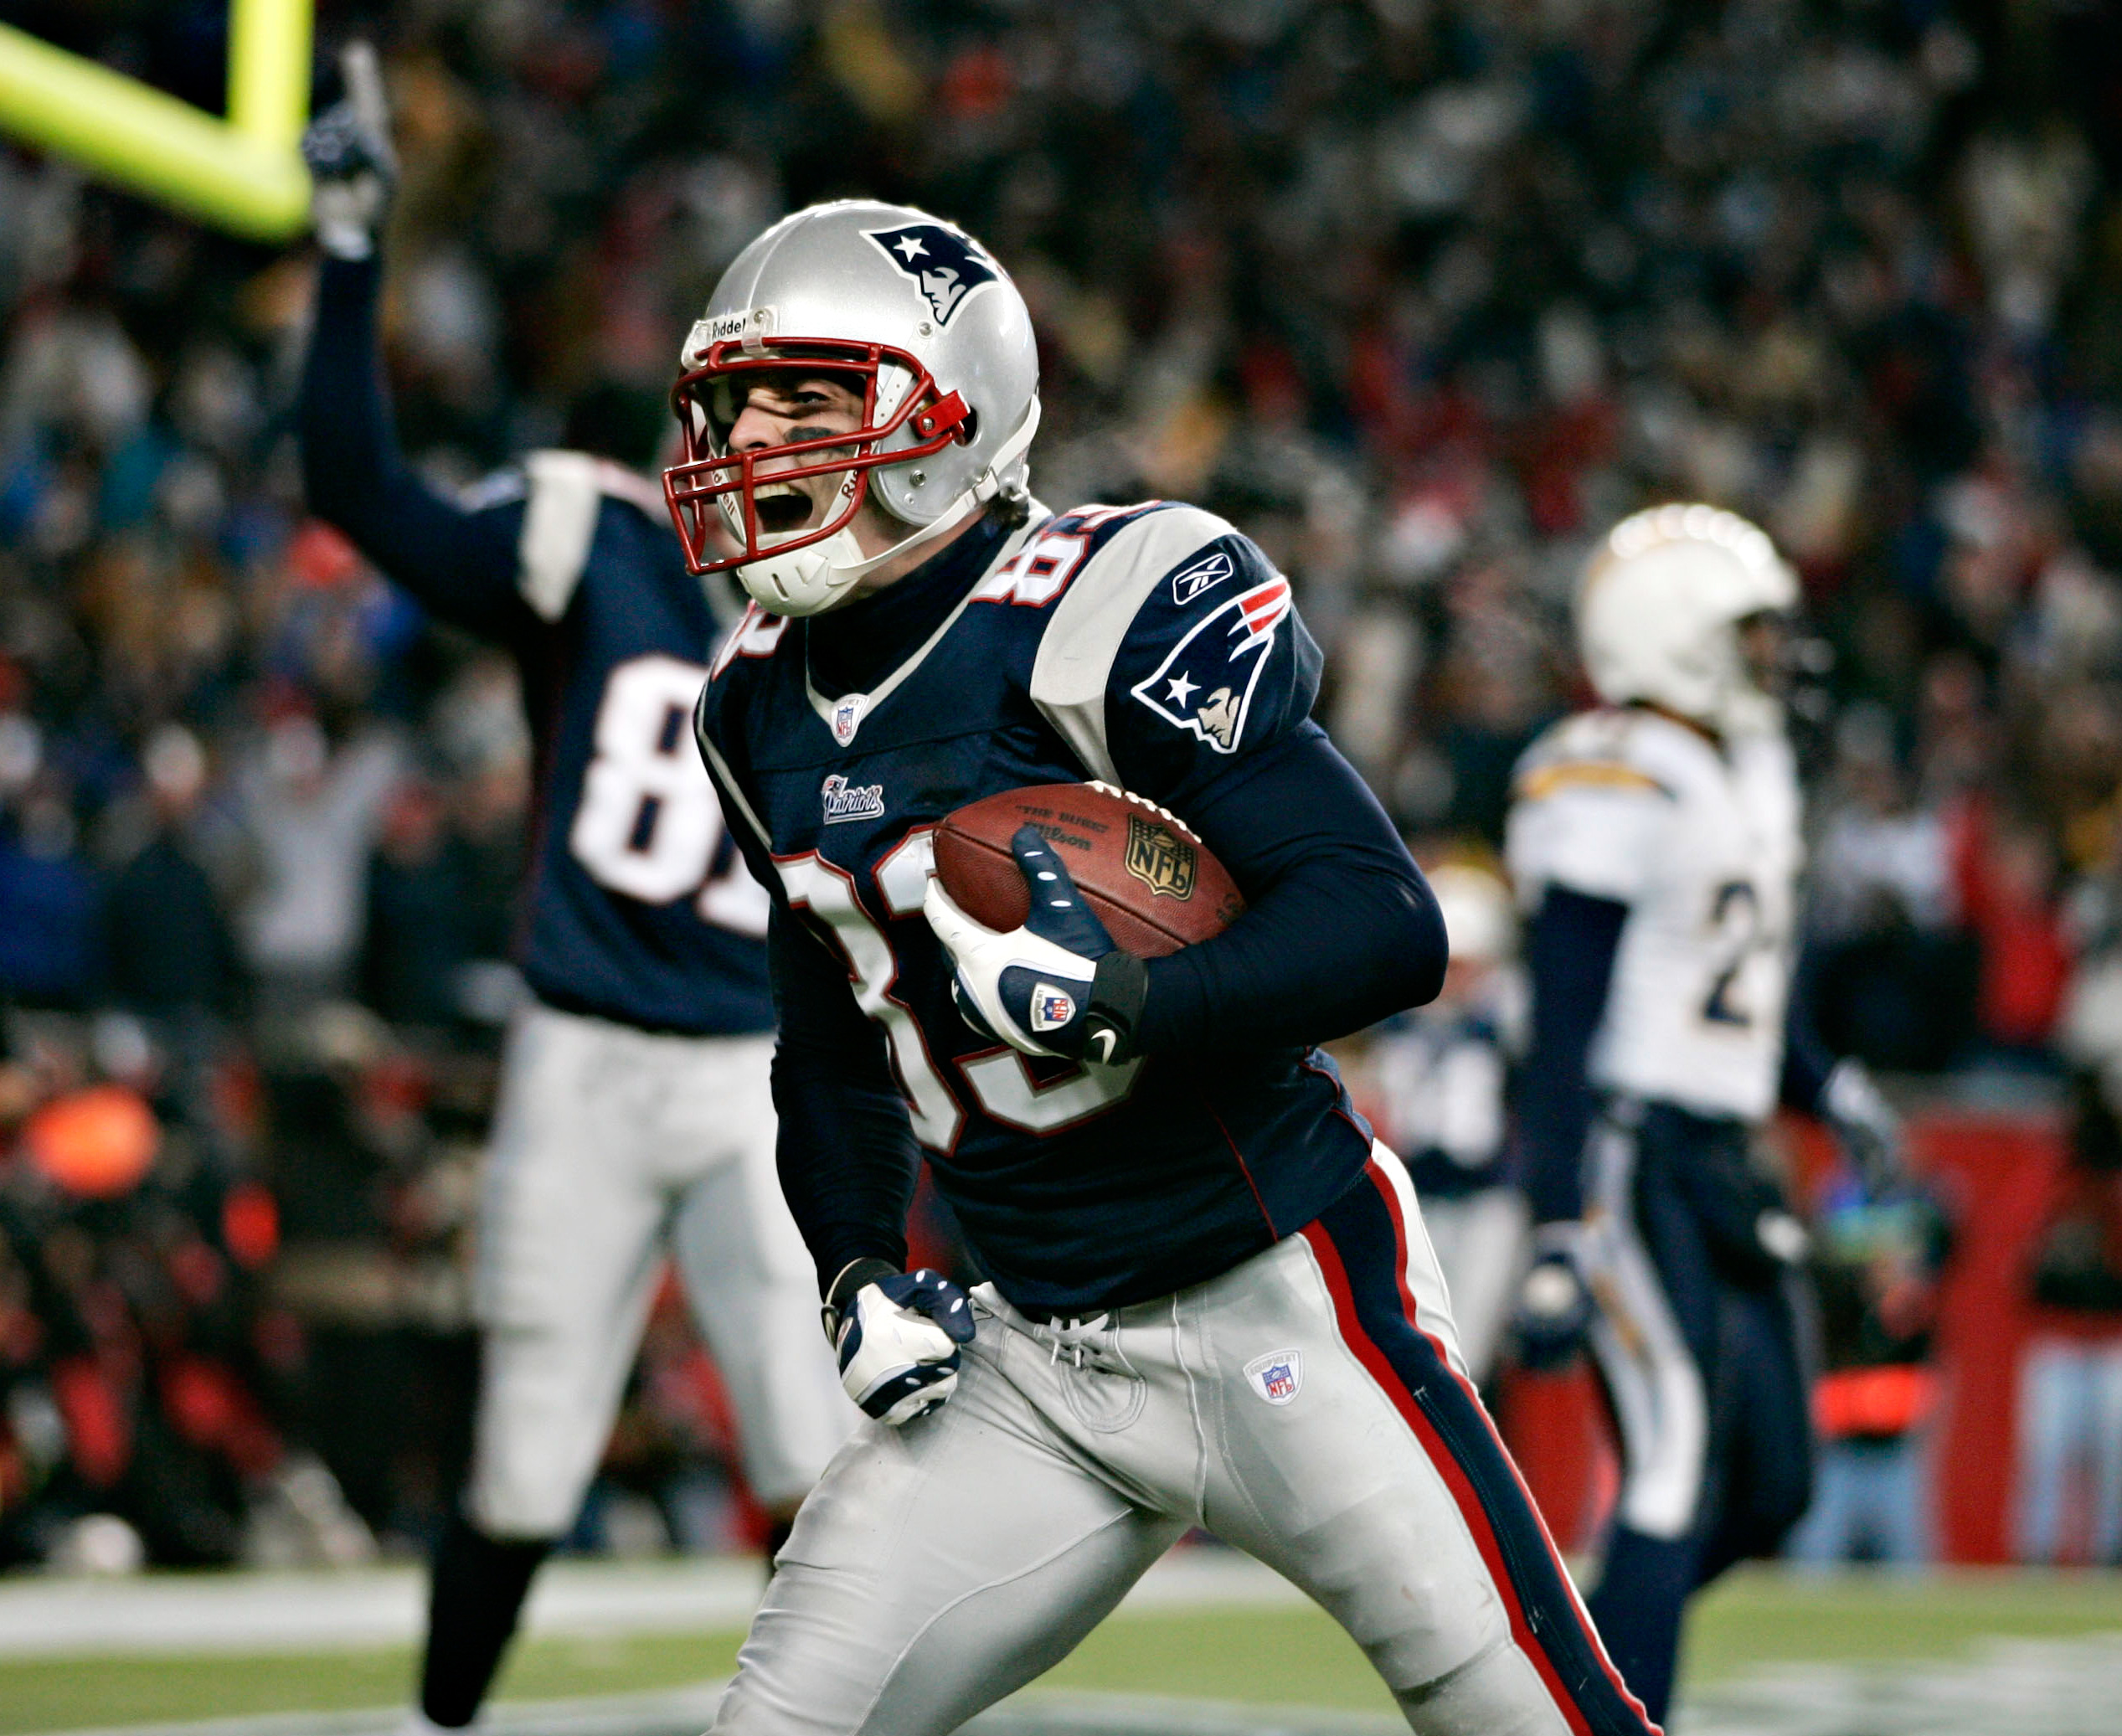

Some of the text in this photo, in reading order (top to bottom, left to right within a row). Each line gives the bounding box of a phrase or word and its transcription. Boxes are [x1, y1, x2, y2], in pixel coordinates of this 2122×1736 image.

[568, 653, 765, 940] 8
[822, 785, 885, 825] Patriots
[1133, 839, 1189, 889] NFL
[1052, 999, 1068, 1019] NFL
[1268, 1378, 1294, 1397] NFL
